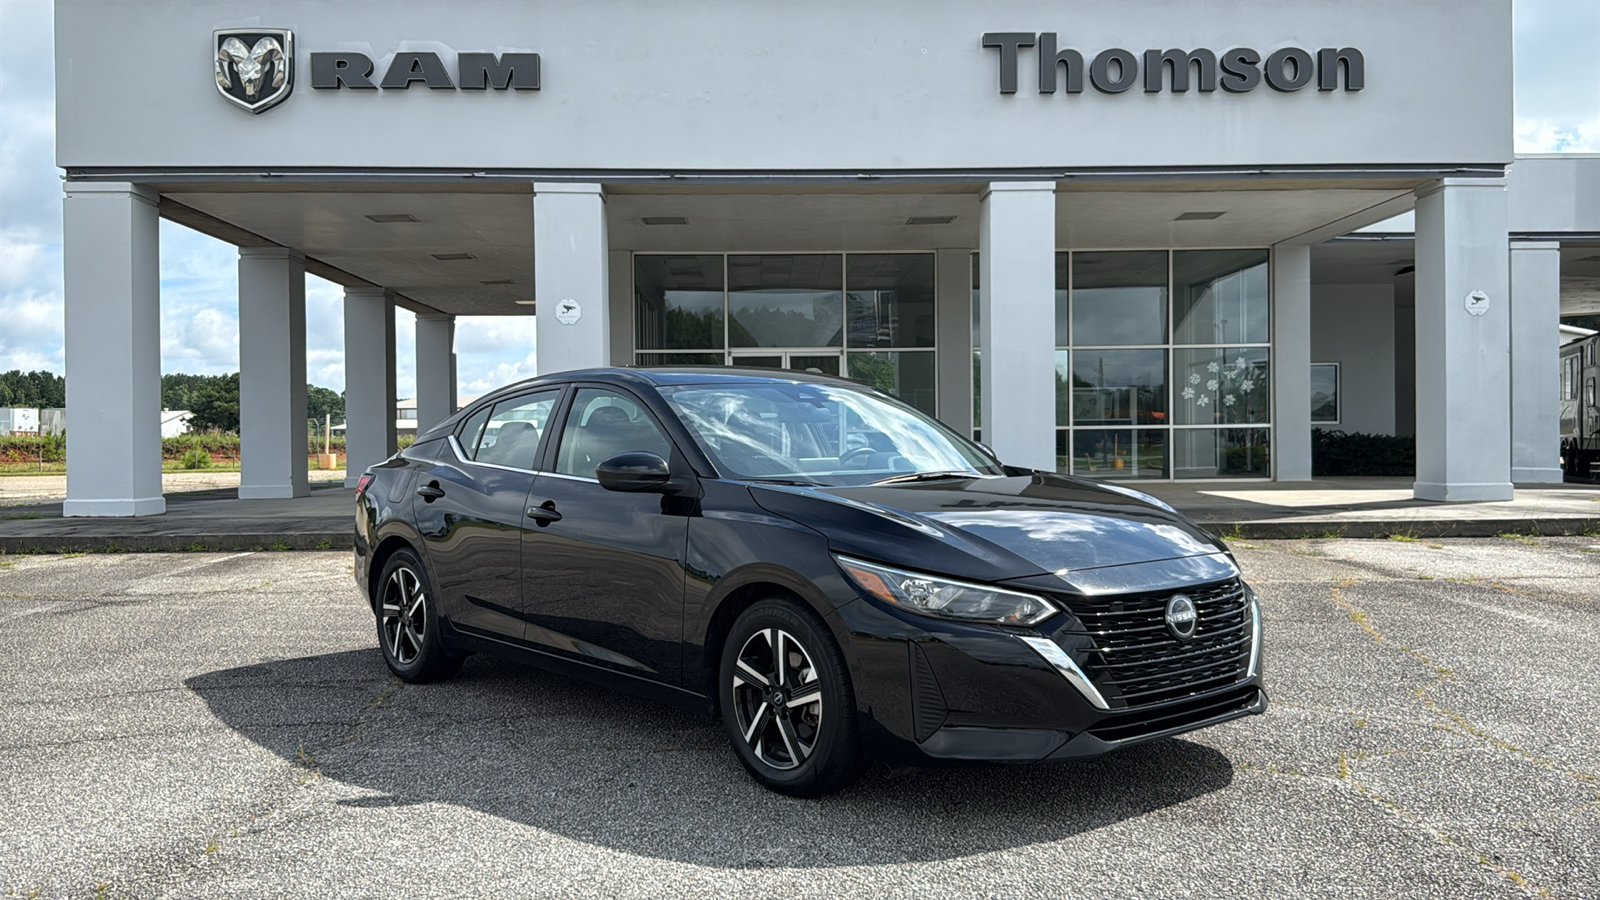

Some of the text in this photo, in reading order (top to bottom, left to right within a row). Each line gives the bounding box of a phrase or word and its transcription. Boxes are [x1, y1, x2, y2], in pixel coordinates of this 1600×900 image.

[310, 52, 541, 91] RAM
[981, 32, 1365, 94] Thomson
[1167, 611, 1197, 622] NISSAN
